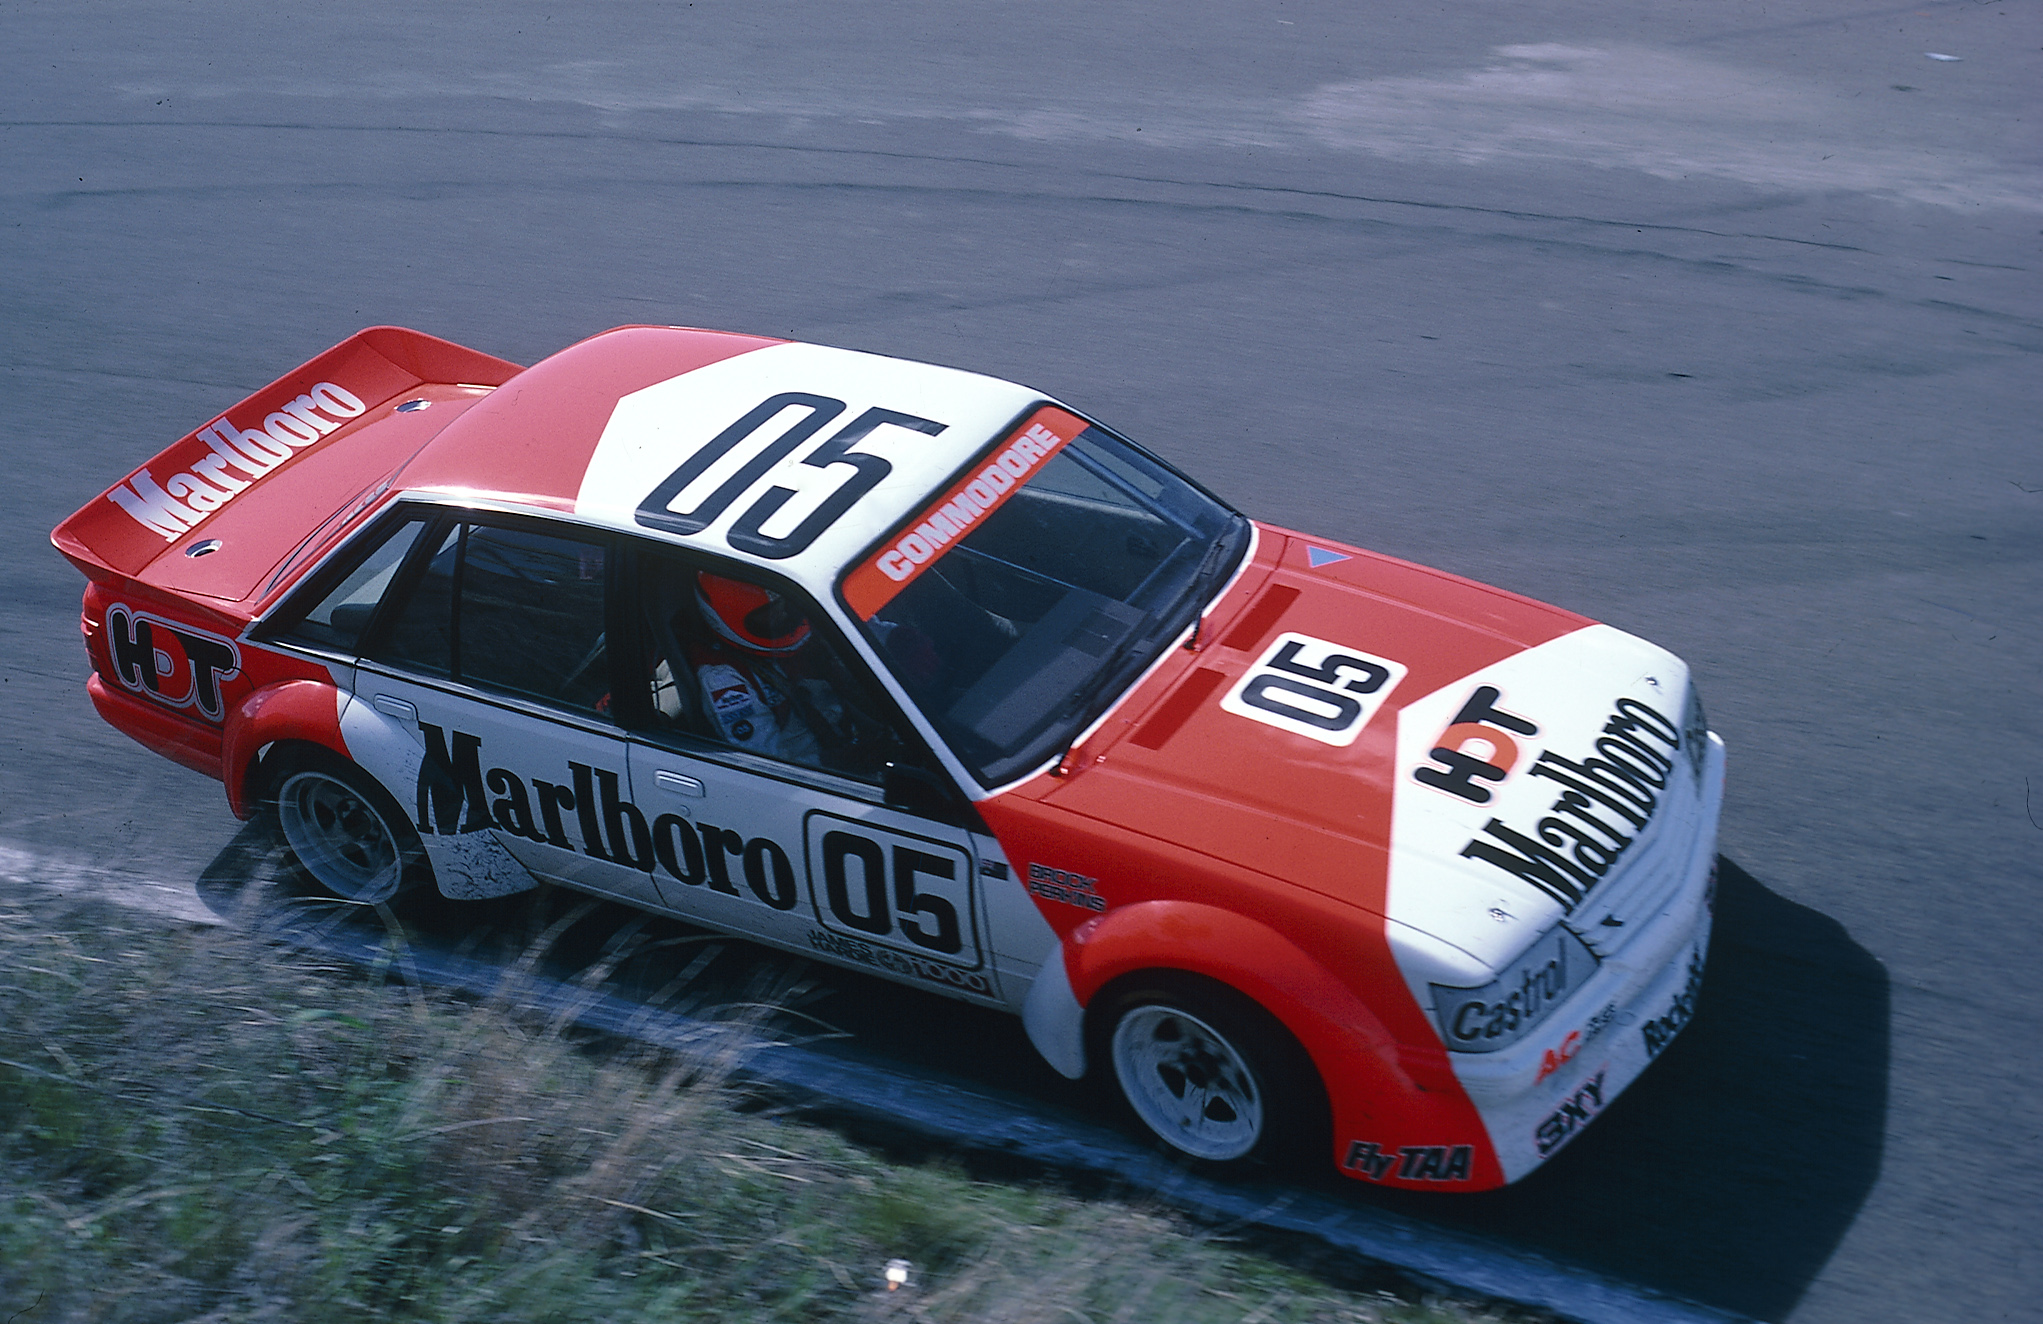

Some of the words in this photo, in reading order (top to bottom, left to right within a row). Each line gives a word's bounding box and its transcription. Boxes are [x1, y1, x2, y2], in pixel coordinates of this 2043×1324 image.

[108, 382, 366, 542] Marlboro
[634, 392, 949, 560] 05
[875, 423, 1060, 582] COMMODORE
[107, 602, 241, 722] HDT
[1241, 640, 1389, 732] 05
[1414, 685, 1538, 804] HDT
[1461, 697, 1680, 914] Marlboro
[416, 721, 797, 911] Marlboro
[823, 830, 961, 955] 05
[1452, 937, 1567, 1041] Castrol
